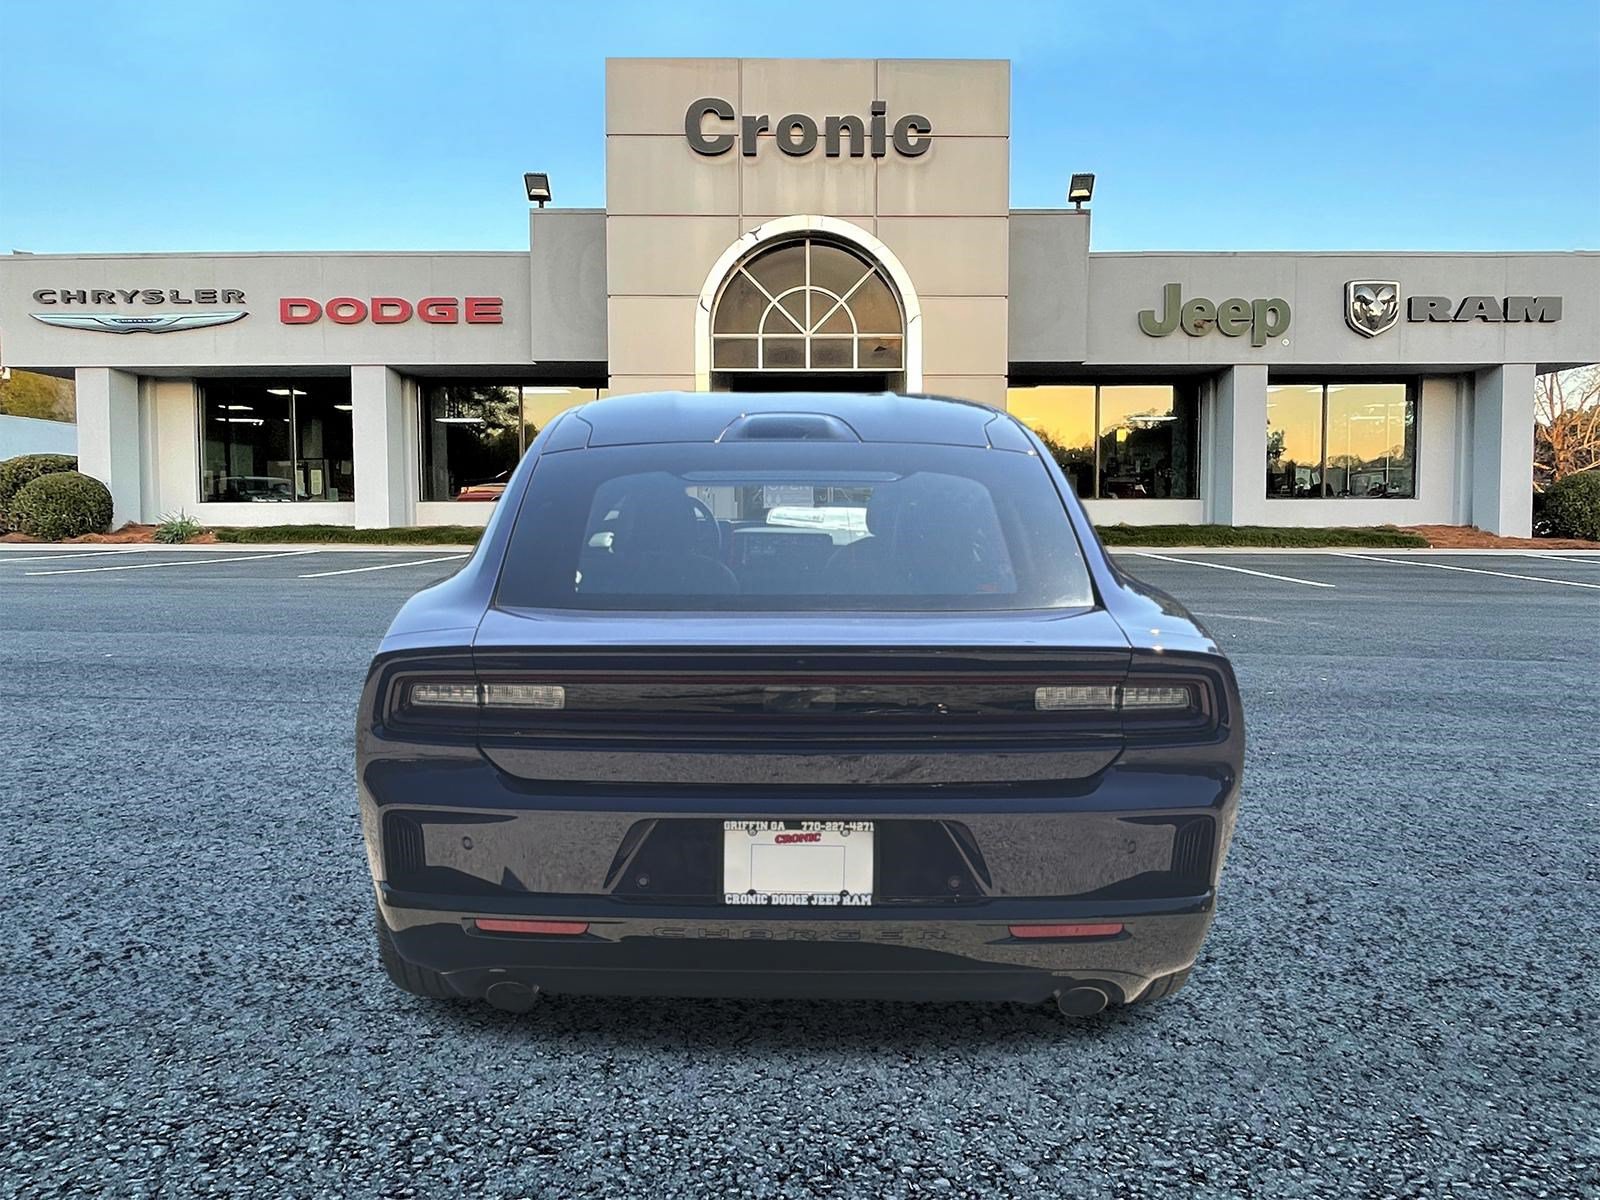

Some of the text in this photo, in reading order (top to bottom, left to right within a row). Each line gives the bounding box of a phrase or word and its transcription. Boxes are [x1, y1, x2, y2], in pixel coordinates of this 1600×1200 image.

[685, 97, 932, 158] Cronic
[32, 288, 247, 304] CHRYSLER
[280, 297, 503, 325] DODGE
[1138, 283, 1292, 347] Jeep
[1407, 296, 1563, 323] RAM
[724, 821, 785, 831] GRIFFIN GA
[801, 821, 874, 831] 770-227-4271
[775, 833, 822, 844] CRONIC
[725, 894, 873, 906] CRONIC DODGE JEEP RAM
[652, 926, 948, 941] CHARGER
